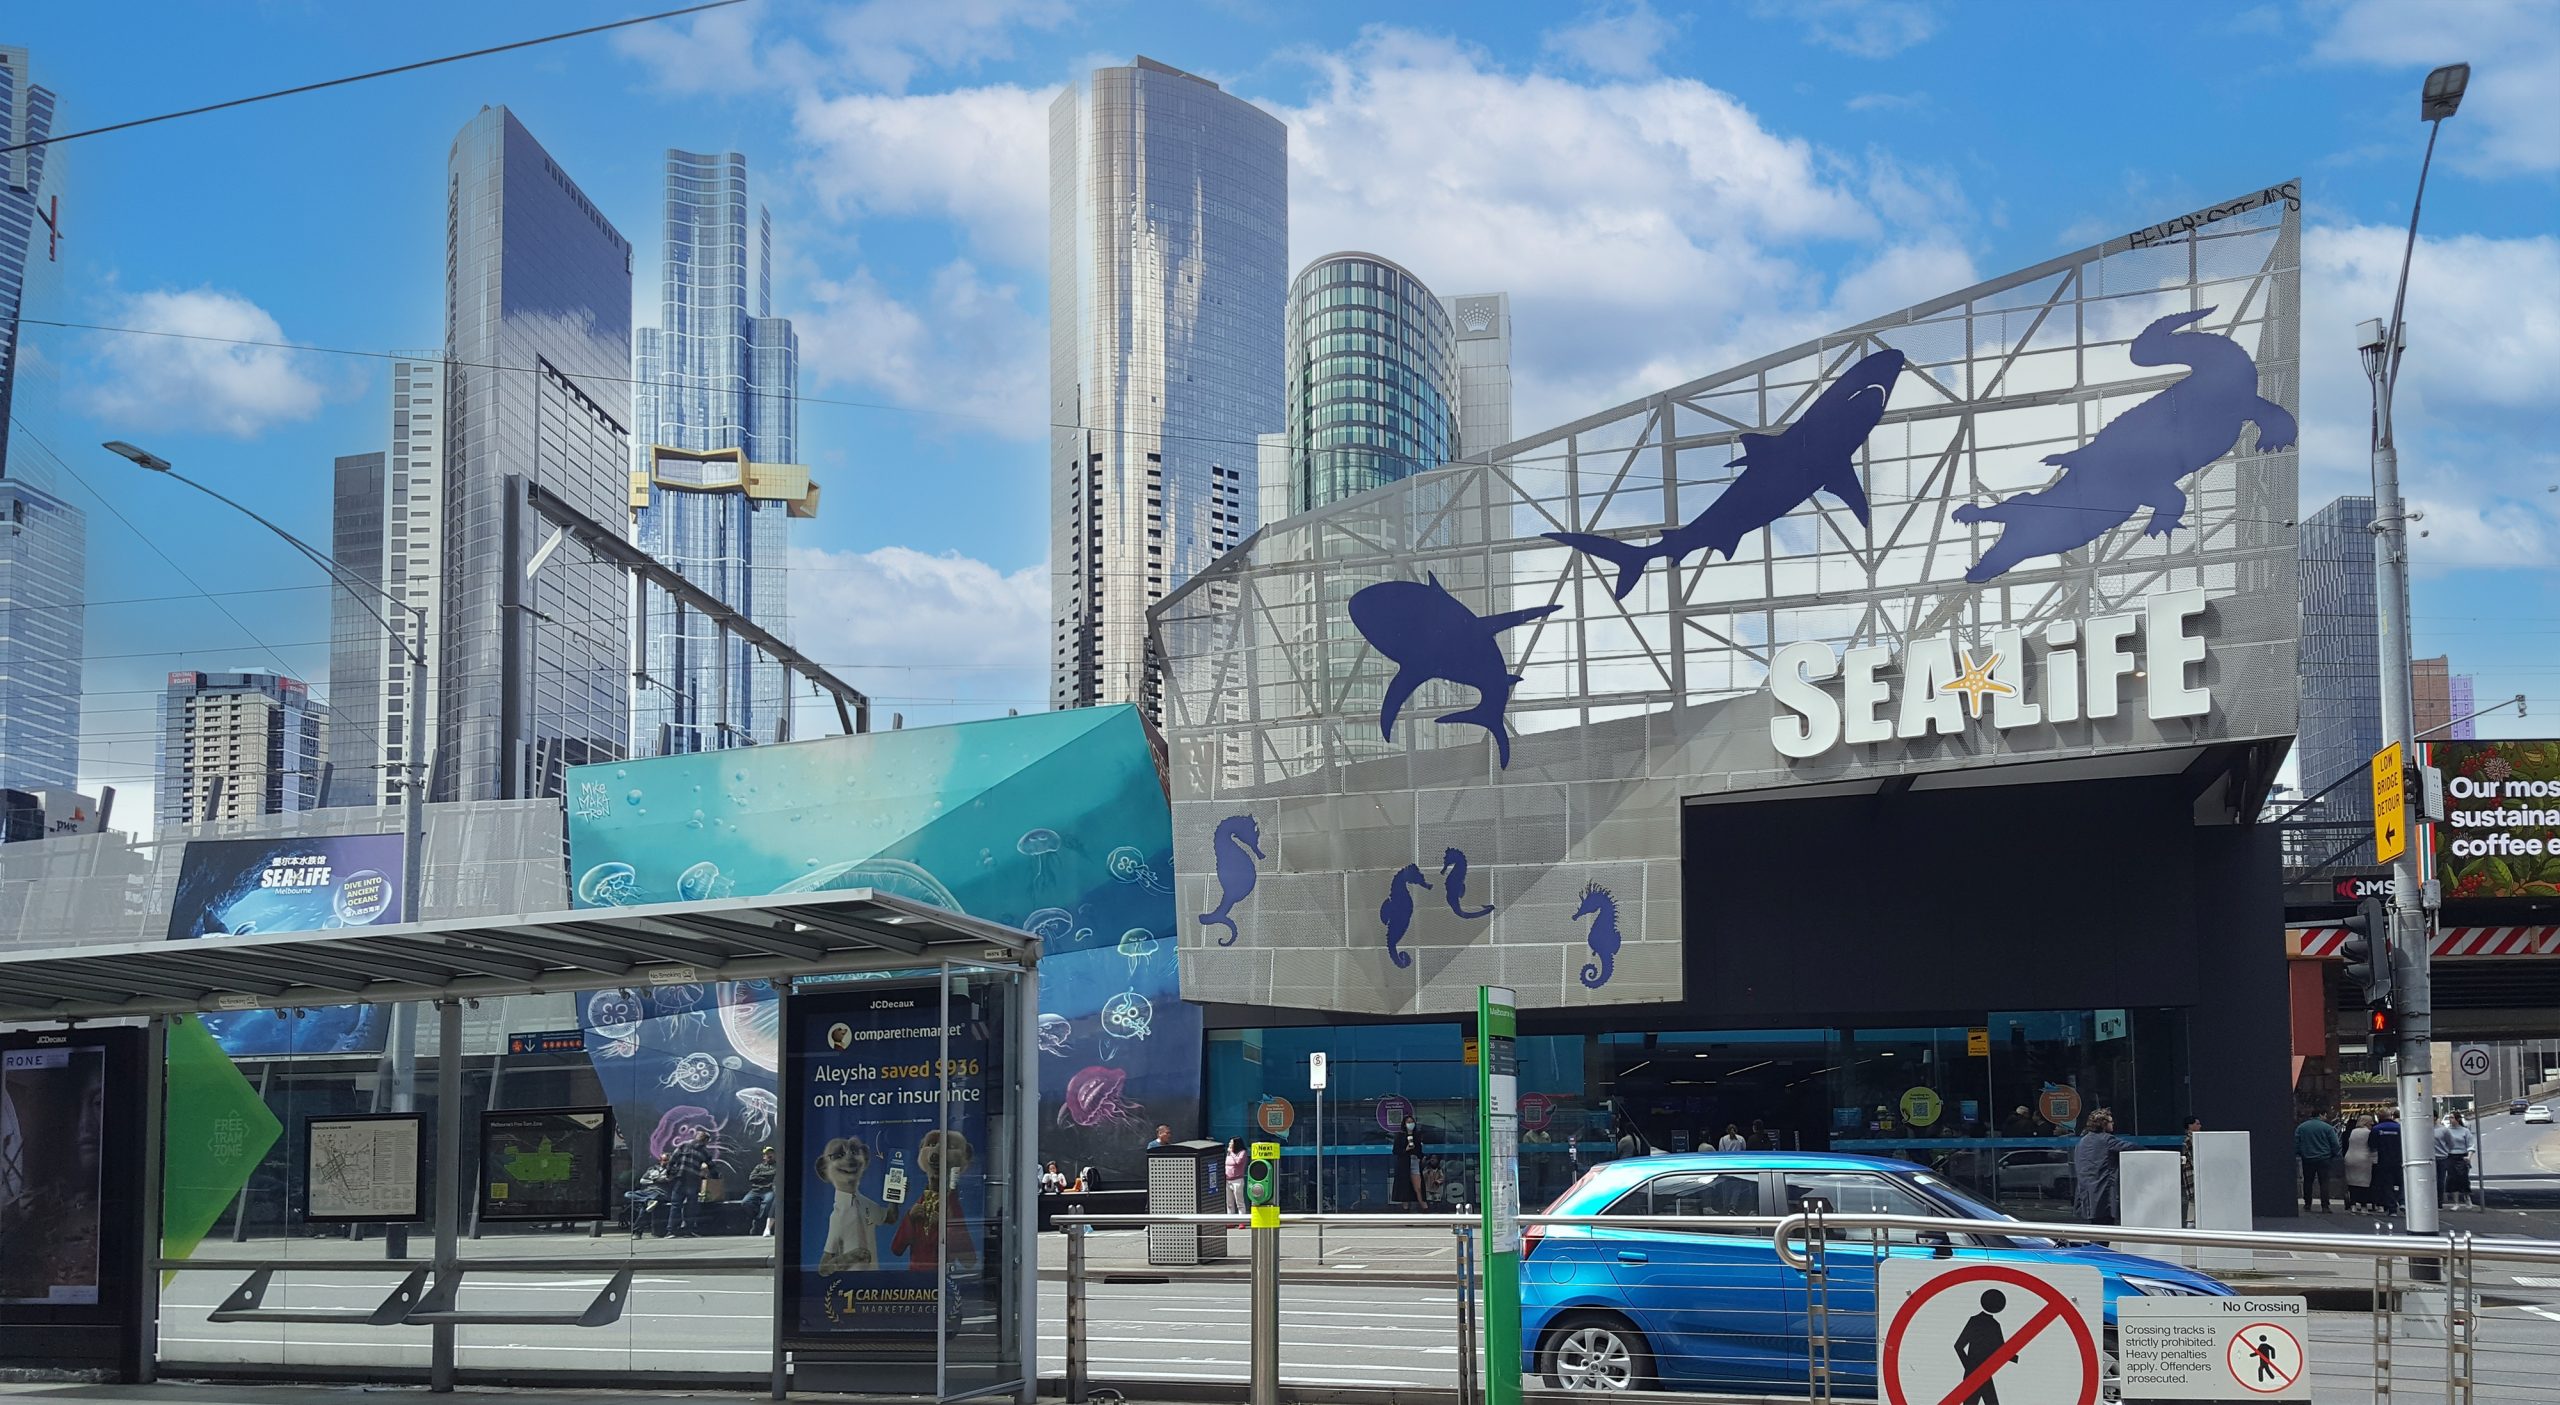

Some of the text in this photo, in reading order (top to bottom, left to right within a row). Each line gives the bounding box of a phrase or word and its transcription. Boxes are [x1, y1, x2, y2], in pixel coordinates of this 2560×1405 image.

[2380, 752, 2392, 772] LOW
[2377, 772, 2398, 796] BRIDGE
[2450, 776, 2499, 798] Our
[2377, 794, 2400, 817] DETOUR
[56, 820, 78, 833] pwc
[2452, 832, 2543, 857] coffee
[343, 876, 382, 891] DIVE INTO
[274, 887, 313, 895] Melbourne
[346, 885, 380, 898] ANCIENT
[347, 894, 378, 907] OCEANS
[869, 1000, 915, 1010] JCDecaux
[36, 1036, 67, 1044] JCDecaux
[6, 1055, 43, 1067] RONE
[2464, 1056, 2486, 1069] 40
[814, 1057, 979, 1086] Aleysha saved $936
[814, 1087, 980, 1108] on her car insurnce
[214, 1118, 243, 1131] FREE
[213, 1131, 242, 1144] TRAM
[213, 1143, 243, 1157] ZONE
[855, 1289, 878, 1301] CAR
[881, 1288, 939, 1301] INSURANC
[861, 1305, 937, 1314] MARKETPLACE
[2223, 1301, 2300, 1314] No Crossing
[2125, 1325, 2216, 1336] Crossing tracks is
[2126, 1337, 2216, 1349] strictly prohibited.
[2126, 1349, 2207, 1361] Heavy penalties
[2127, 1361, 2212, 1373] apply. Offenders
[2127, 1374, 2188, 1385] prosecuted.
